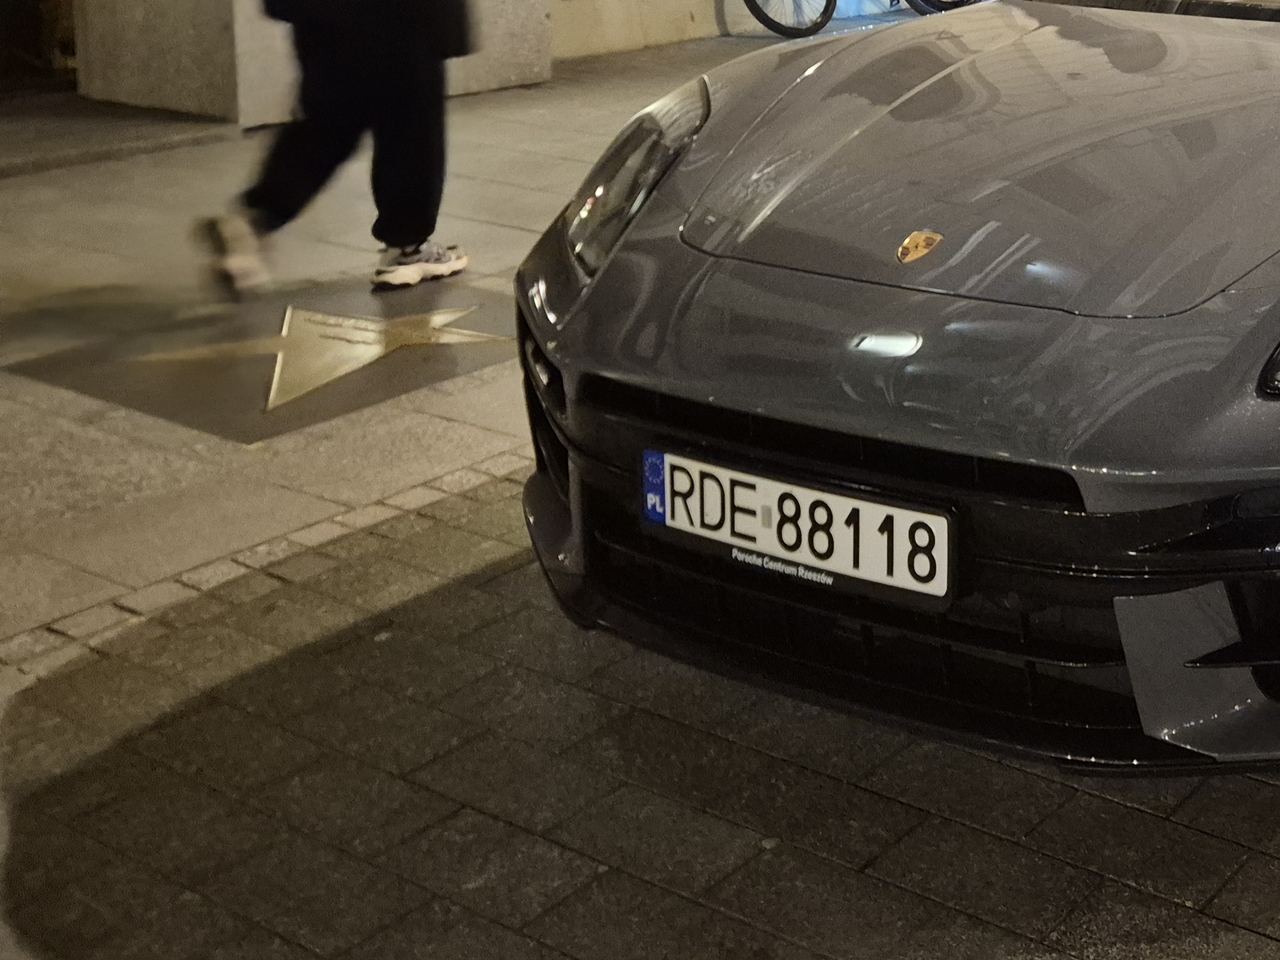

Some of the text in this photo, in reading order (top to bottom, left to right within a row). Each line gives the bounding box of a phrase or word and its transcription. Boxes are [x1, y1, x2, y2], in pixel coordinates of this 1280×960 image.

[646, 493, 664, 514] PL
[670, 463, 938, 584] RDE 88118
[731, 547, 834, 585] Porsche Centrum Rzeszów
